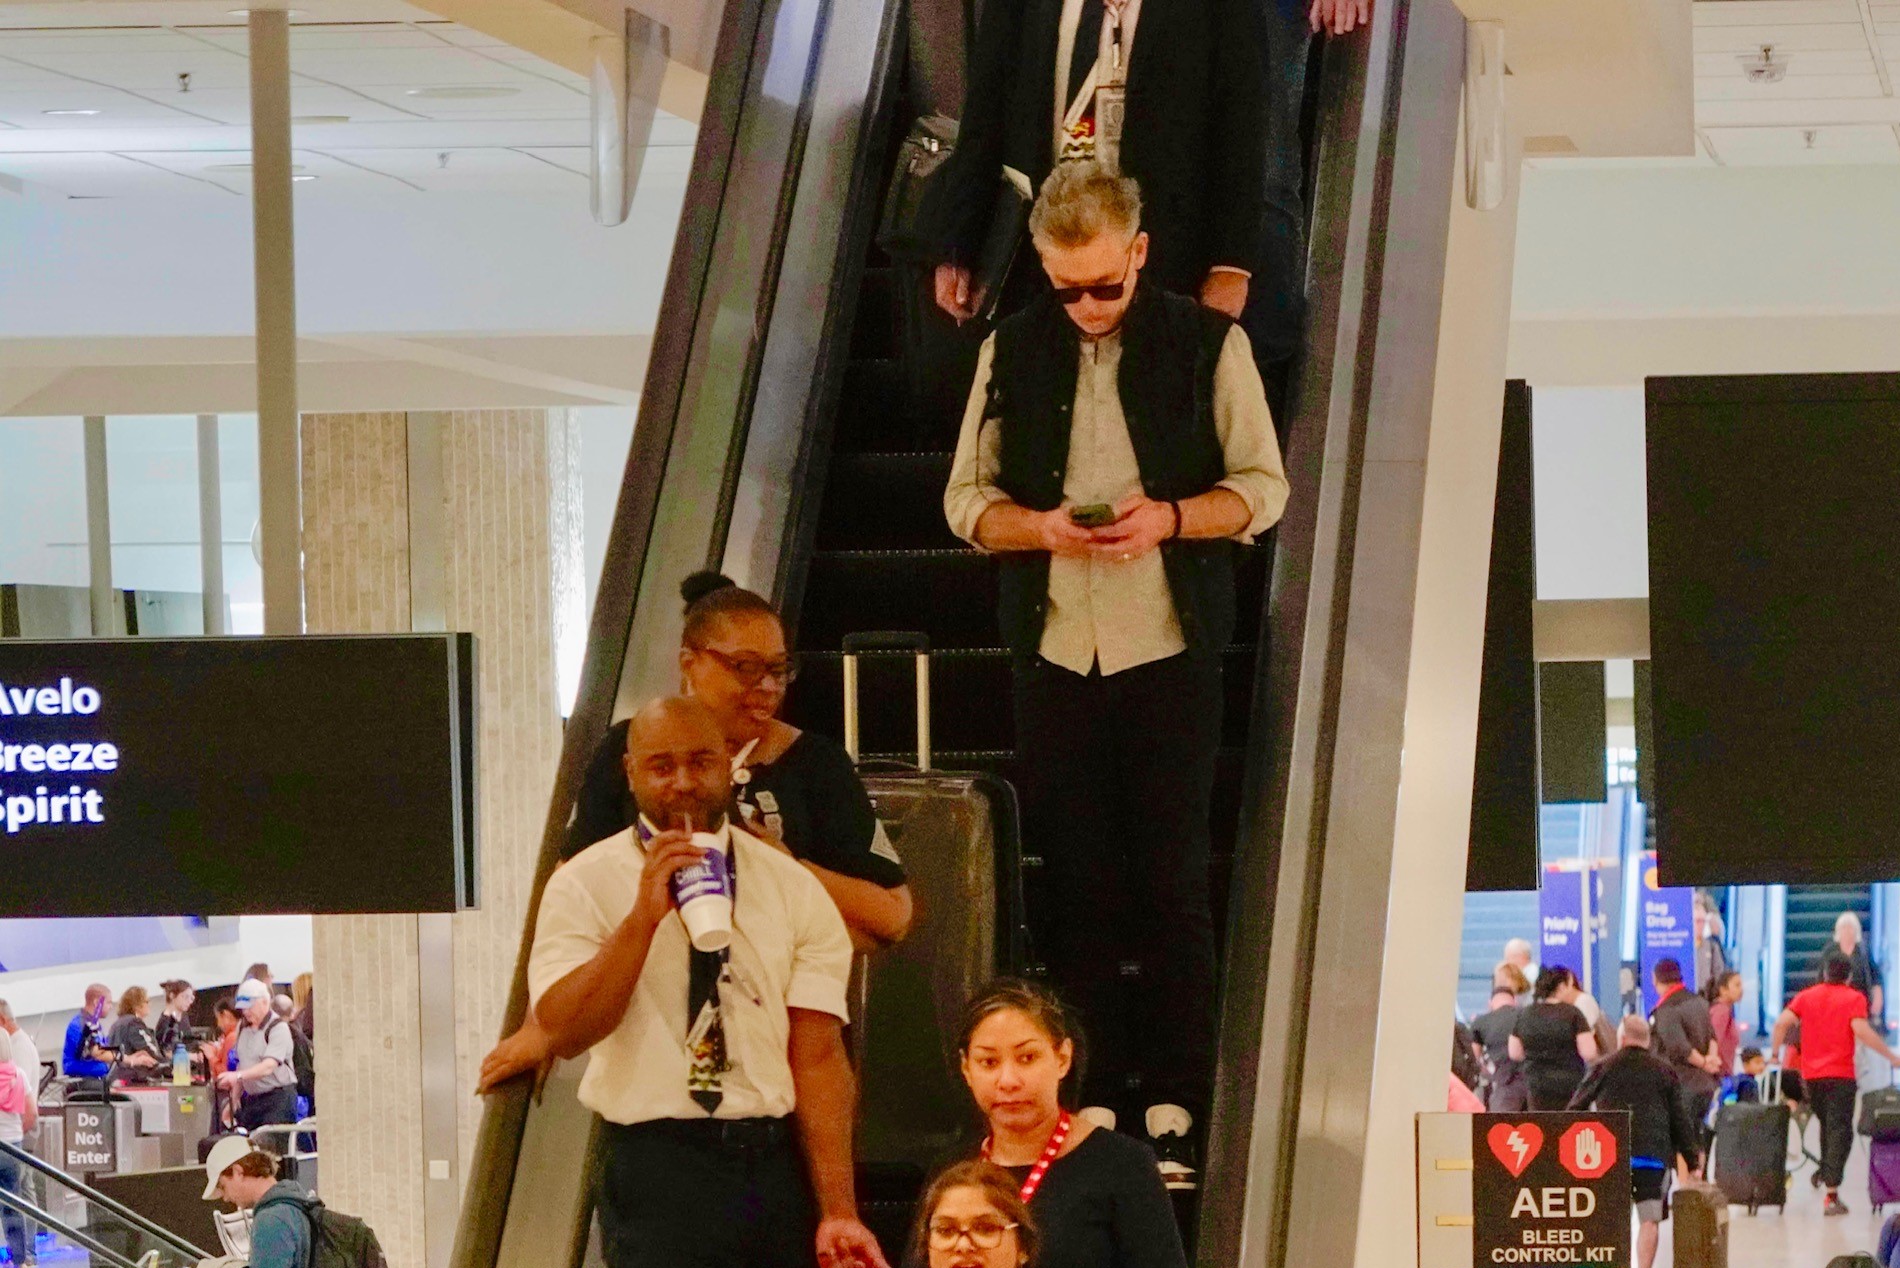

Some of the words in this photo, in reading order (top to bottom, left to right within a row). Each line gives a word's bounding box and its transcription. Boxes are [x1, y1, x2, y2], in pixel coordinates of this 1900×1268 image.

[0, 740, 119, 773] reeze
[0, 785, 105, 833] pirit
[77, 1112, 99, 1127] Do
[74, 1131, 103, 1146] Not
[67, 1150, 111, 1165] Enter
[1510, 1186, 1596, 1219] AED
[1522, 1228, 1584, 1245] BLEED
[1491, 1247, 1582, 1263] CONTROL
[1586, 1246, 1616, 1262] KIT
